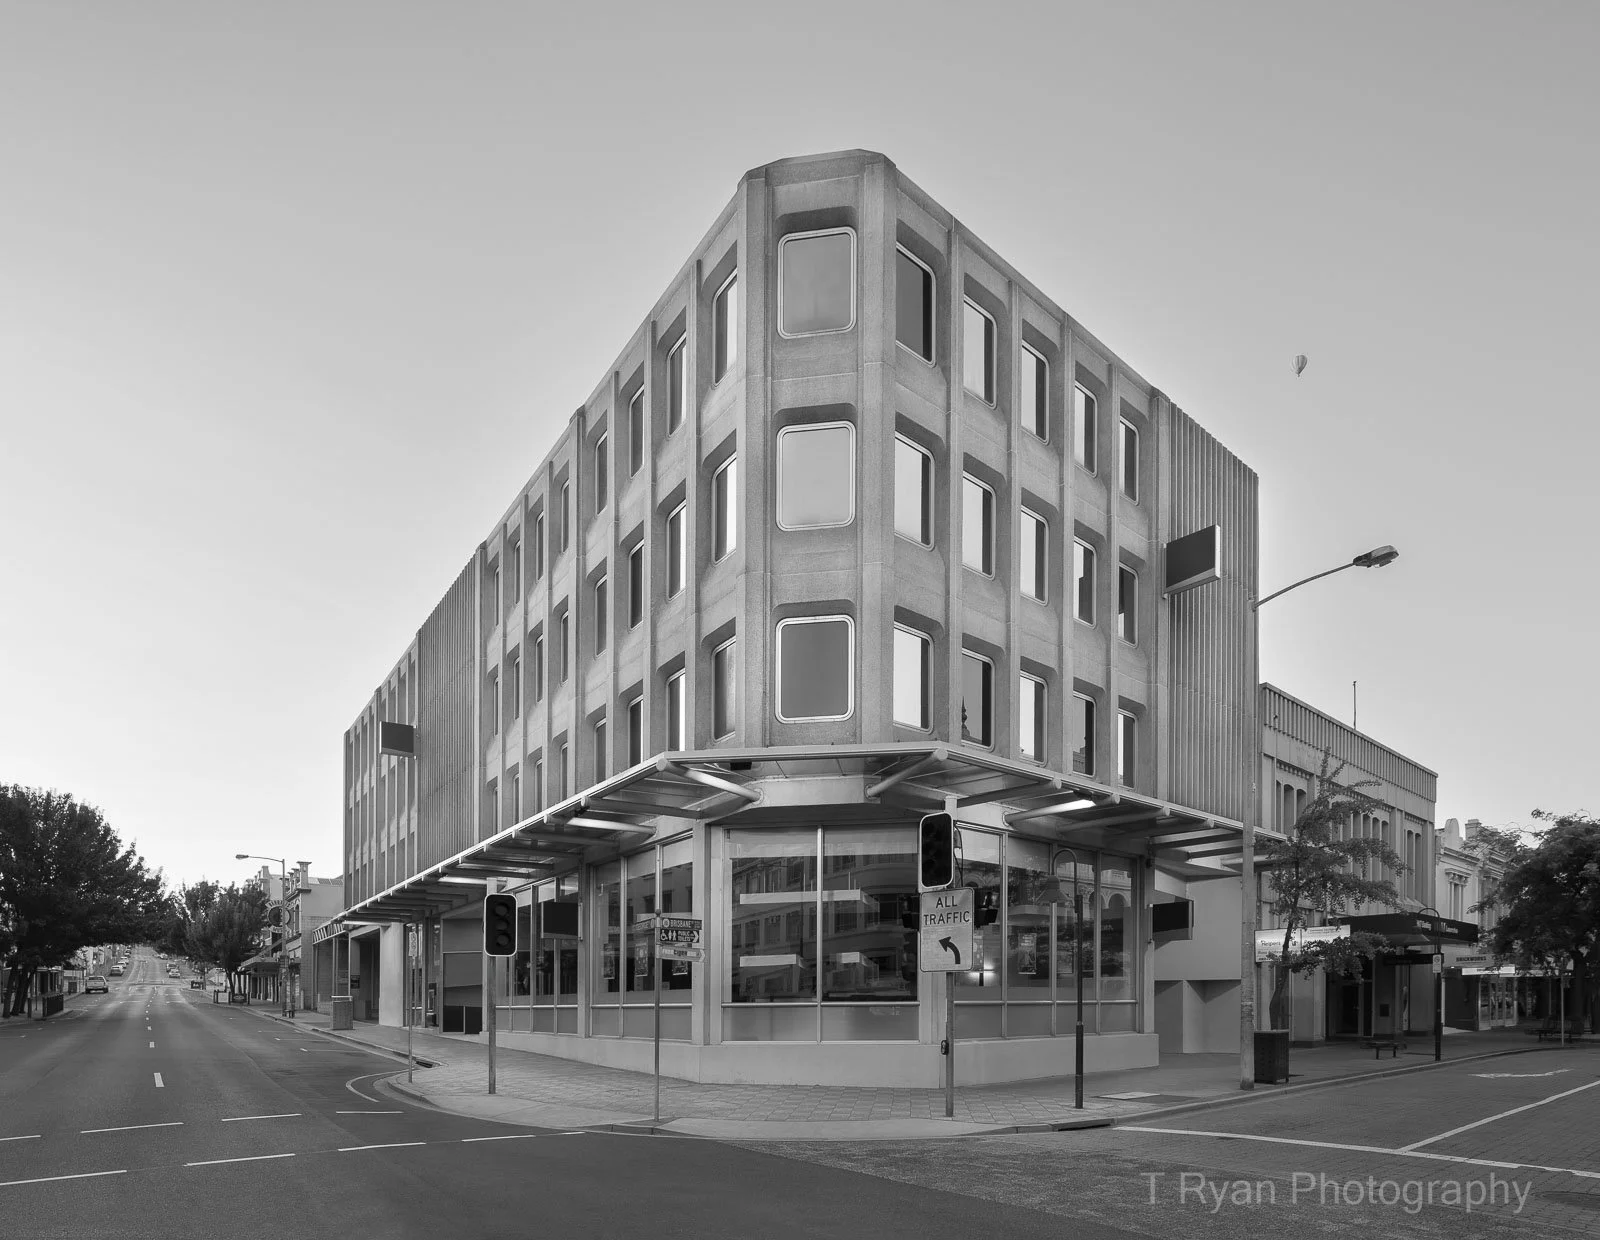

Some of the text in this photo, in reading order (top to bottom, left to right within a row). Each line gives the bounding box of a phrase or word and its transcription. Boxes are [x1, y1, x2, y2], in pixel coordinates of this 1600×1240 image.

[936, 896, 958, 908] ALL
[670, 920, 692, 928] BRISBANE
[923, 910, 970, 926] TRAFFIC
